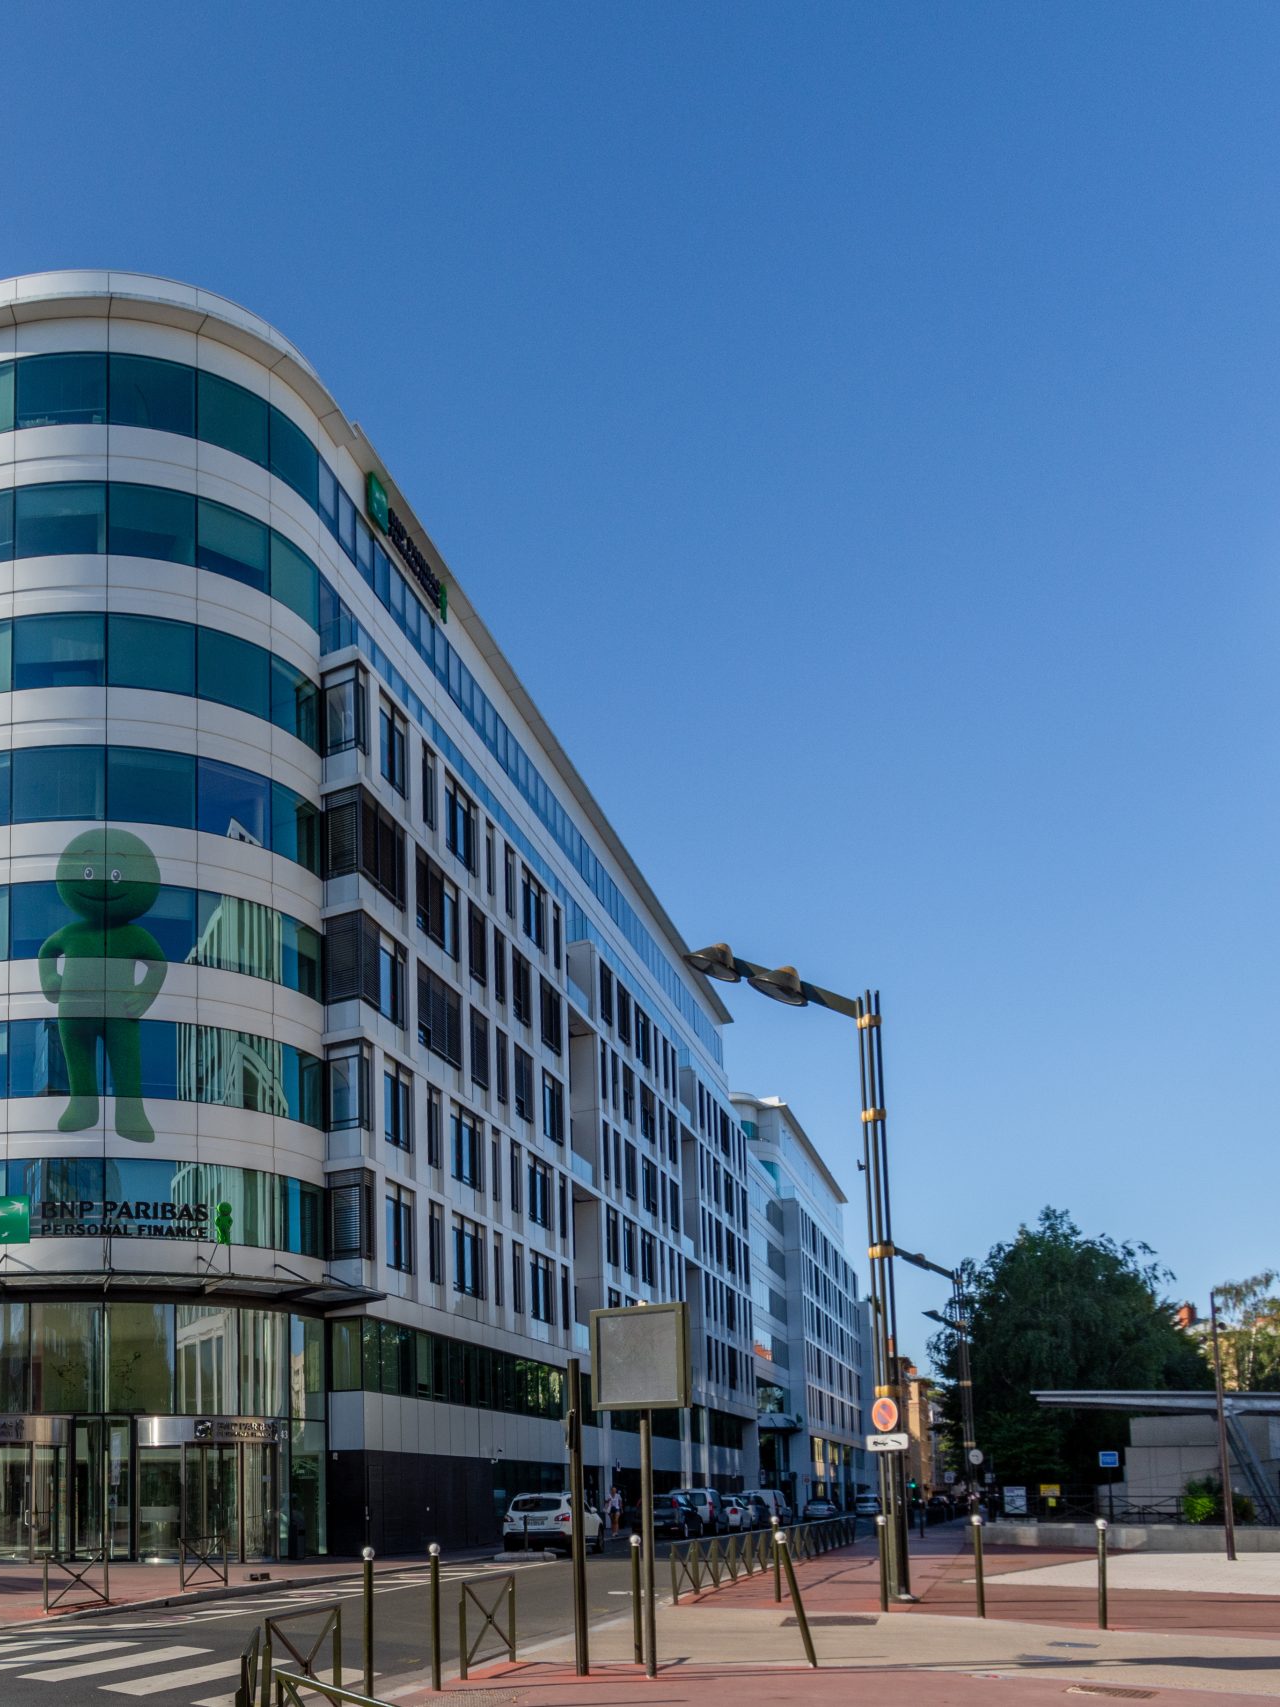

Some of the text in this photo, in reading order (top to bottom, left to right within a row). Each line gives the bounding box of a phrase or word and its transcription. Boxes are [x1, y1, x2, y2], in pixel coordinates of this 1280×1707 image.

[41, 1201, 209, 1222] BNP PARIBAS
[41, 1224, 209, 1239] PERSONAL FINANCE
